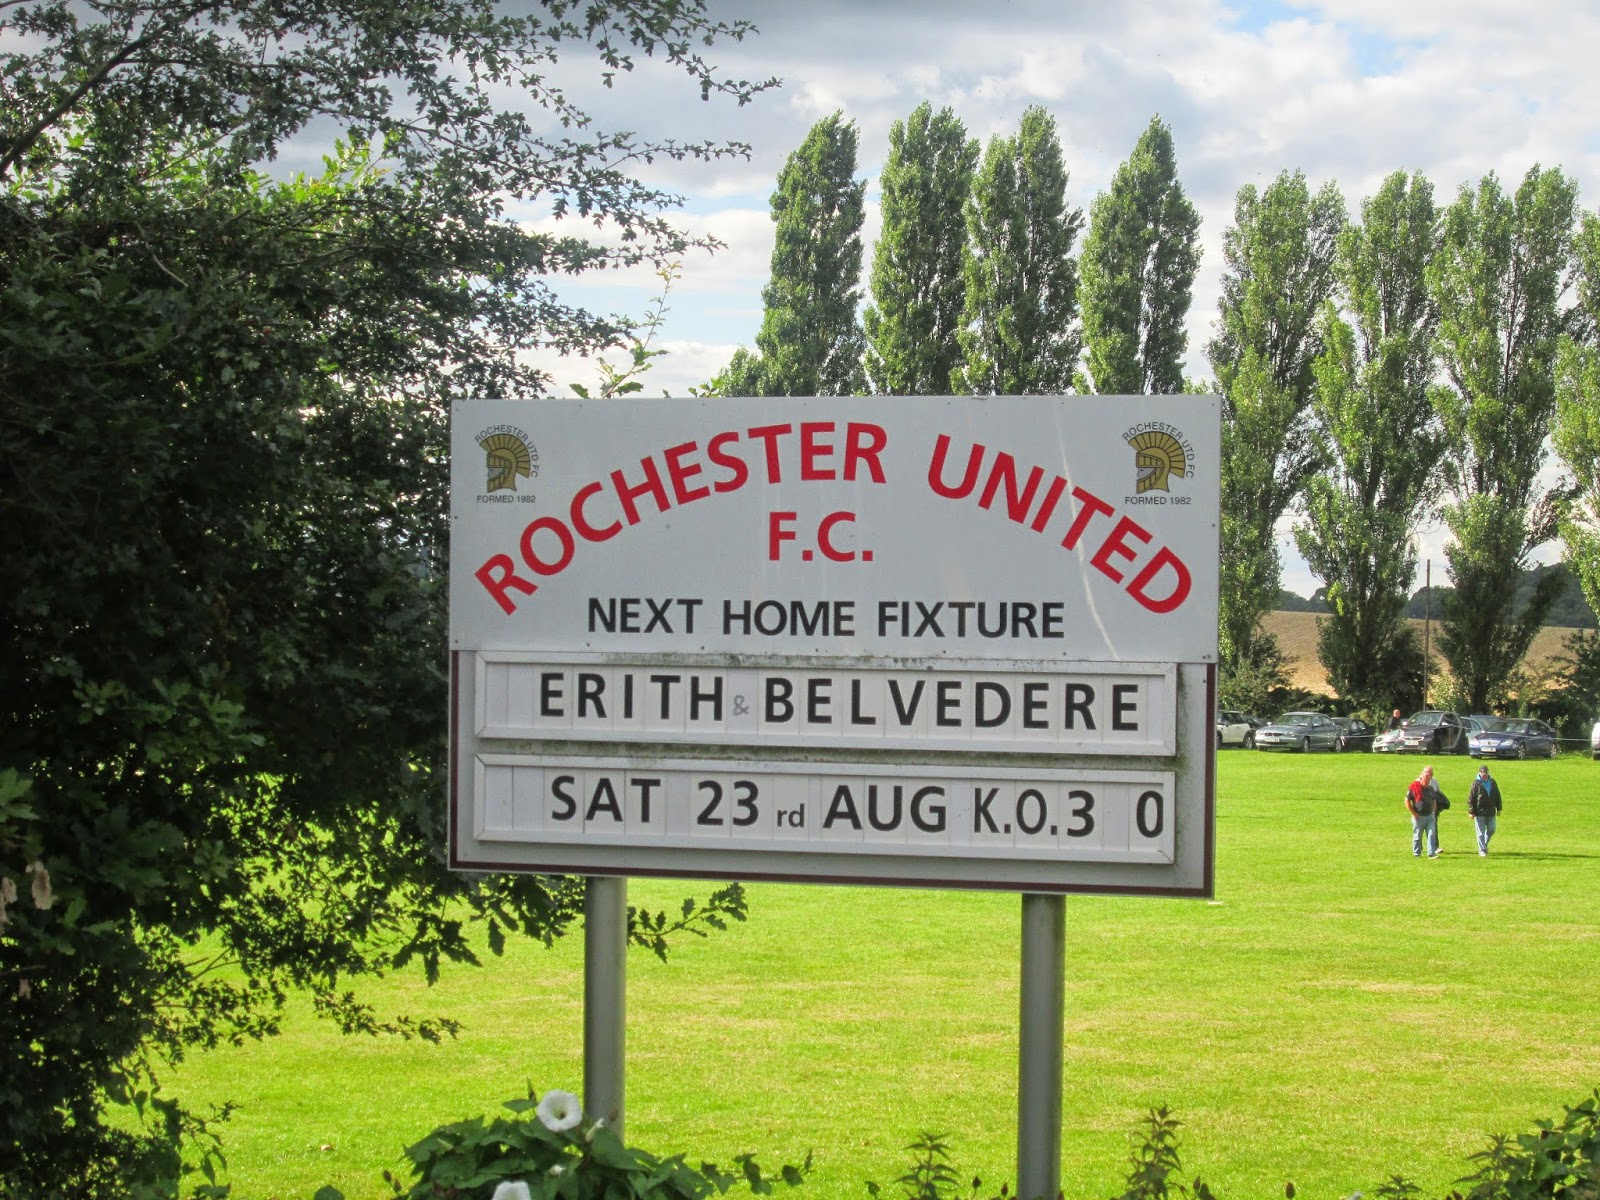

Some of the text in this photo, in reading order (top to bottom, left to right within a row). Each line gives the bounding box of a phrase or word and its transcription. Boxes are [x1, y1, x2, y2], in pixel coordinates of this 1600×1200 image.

[474, 424, 539, 478] ROCHESTER UTD FC
[1122, 421, 1196, 478] ROCHESTER UTD FC
[474, 421, 1192, 616] ROCHESTER UNITED
[476, 495, 536, 503] FORMED 1982
[1124, 496, 1192, 505] FORMED 1982
[768, 511, 874, 563] F.C.
[587, 597, 1065, 639] NEXT HOME FIXTURE
[540, 672, 1139, 732] ERITH & BELVEDERE
[551, 775, 661, 823] SAT
[822, 784, 947, 833] AUG
